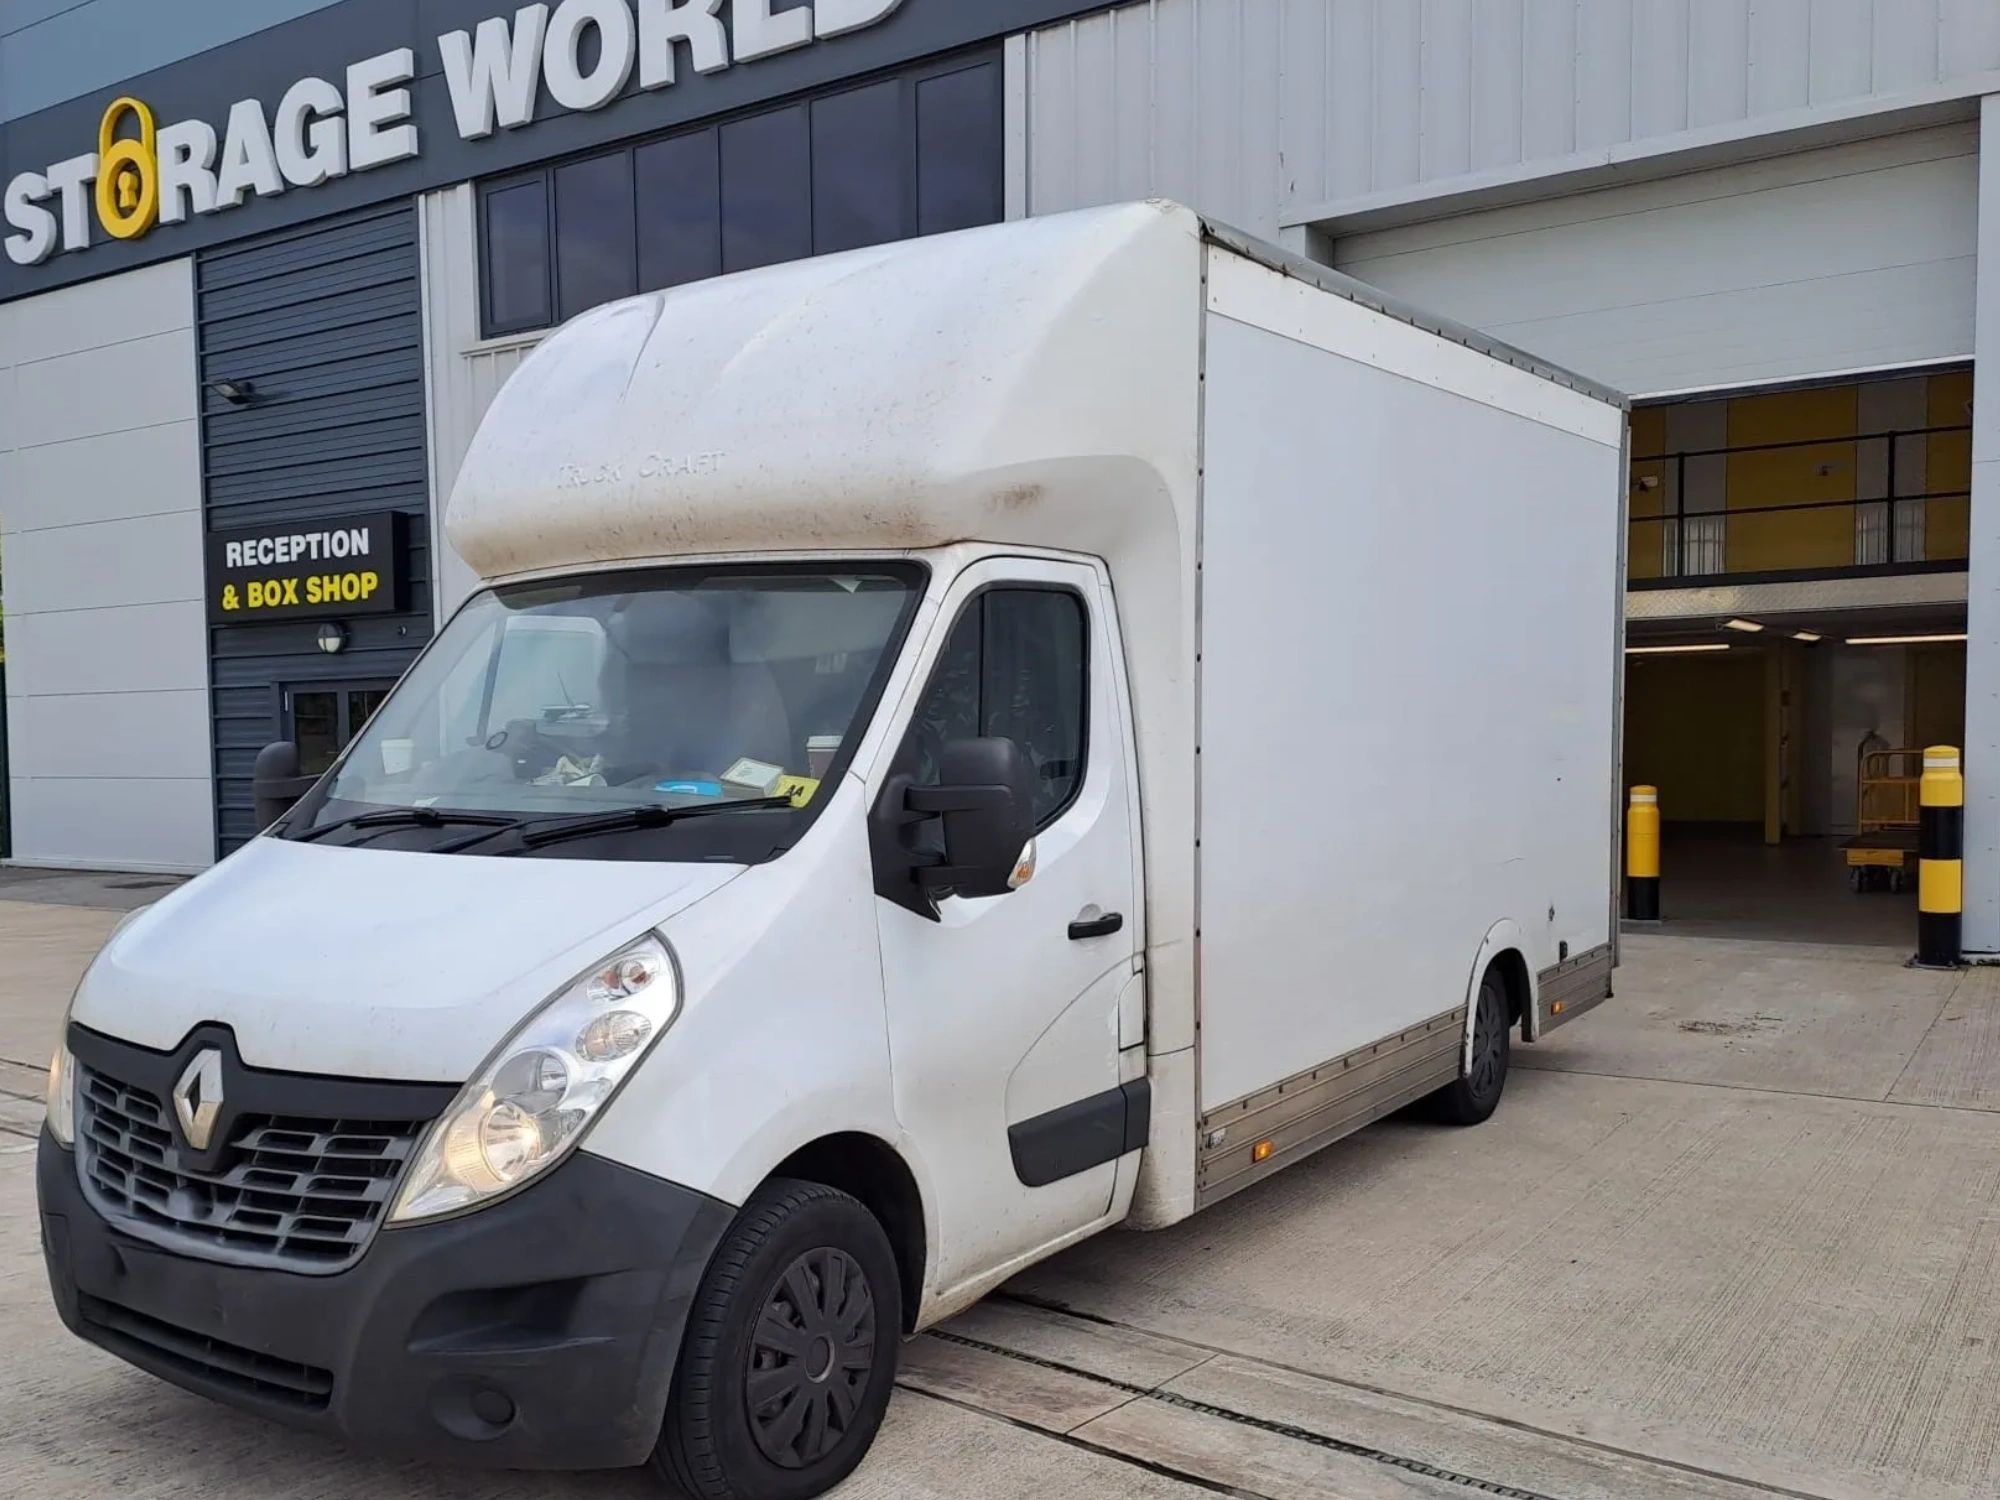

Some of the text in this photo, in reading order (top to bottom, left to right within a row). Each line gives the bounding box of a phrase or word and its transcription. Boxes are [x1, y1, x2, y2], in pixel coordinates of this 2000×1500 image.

[3, 50, 419, 265] STORAGE
[226, 528, 369, 568] RECEPTION
[222, 571, 378, 610] & BOX SHOP
